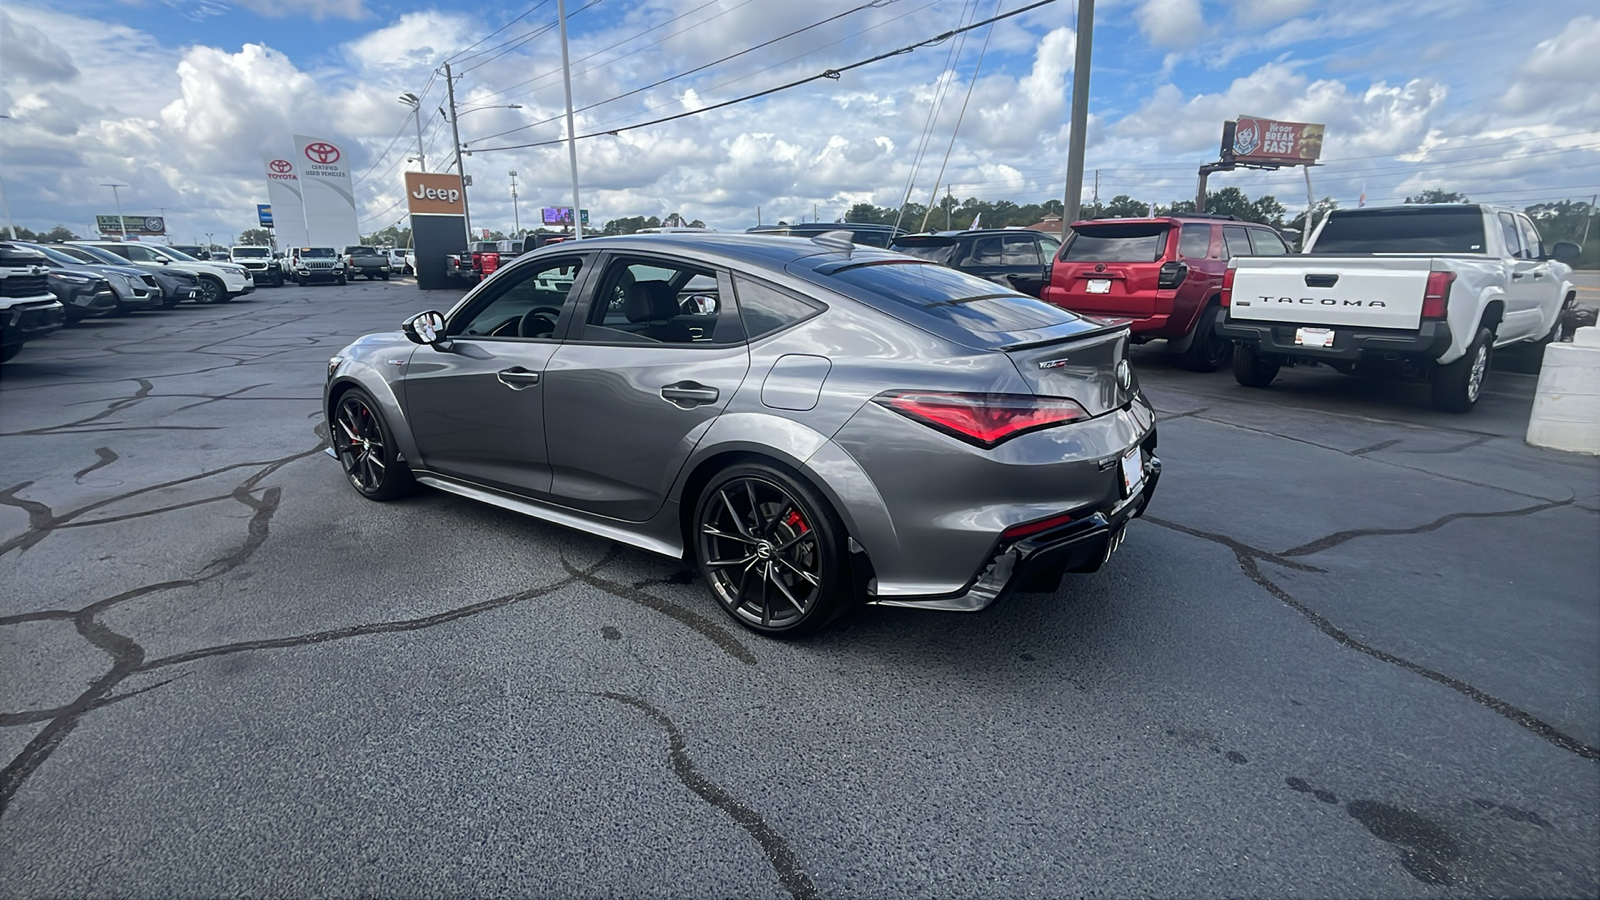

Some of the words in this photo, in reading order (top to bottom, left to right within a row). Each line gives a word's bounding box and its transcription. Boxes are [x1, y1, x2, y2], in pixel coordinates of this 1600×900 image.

[1264, 132, 1295, 142] BREAK
[1263, 141, 1294, 153] FAST
[412, 184, 460, 203] Jeep
[1258, 296, 1386, 308] TACOMA
